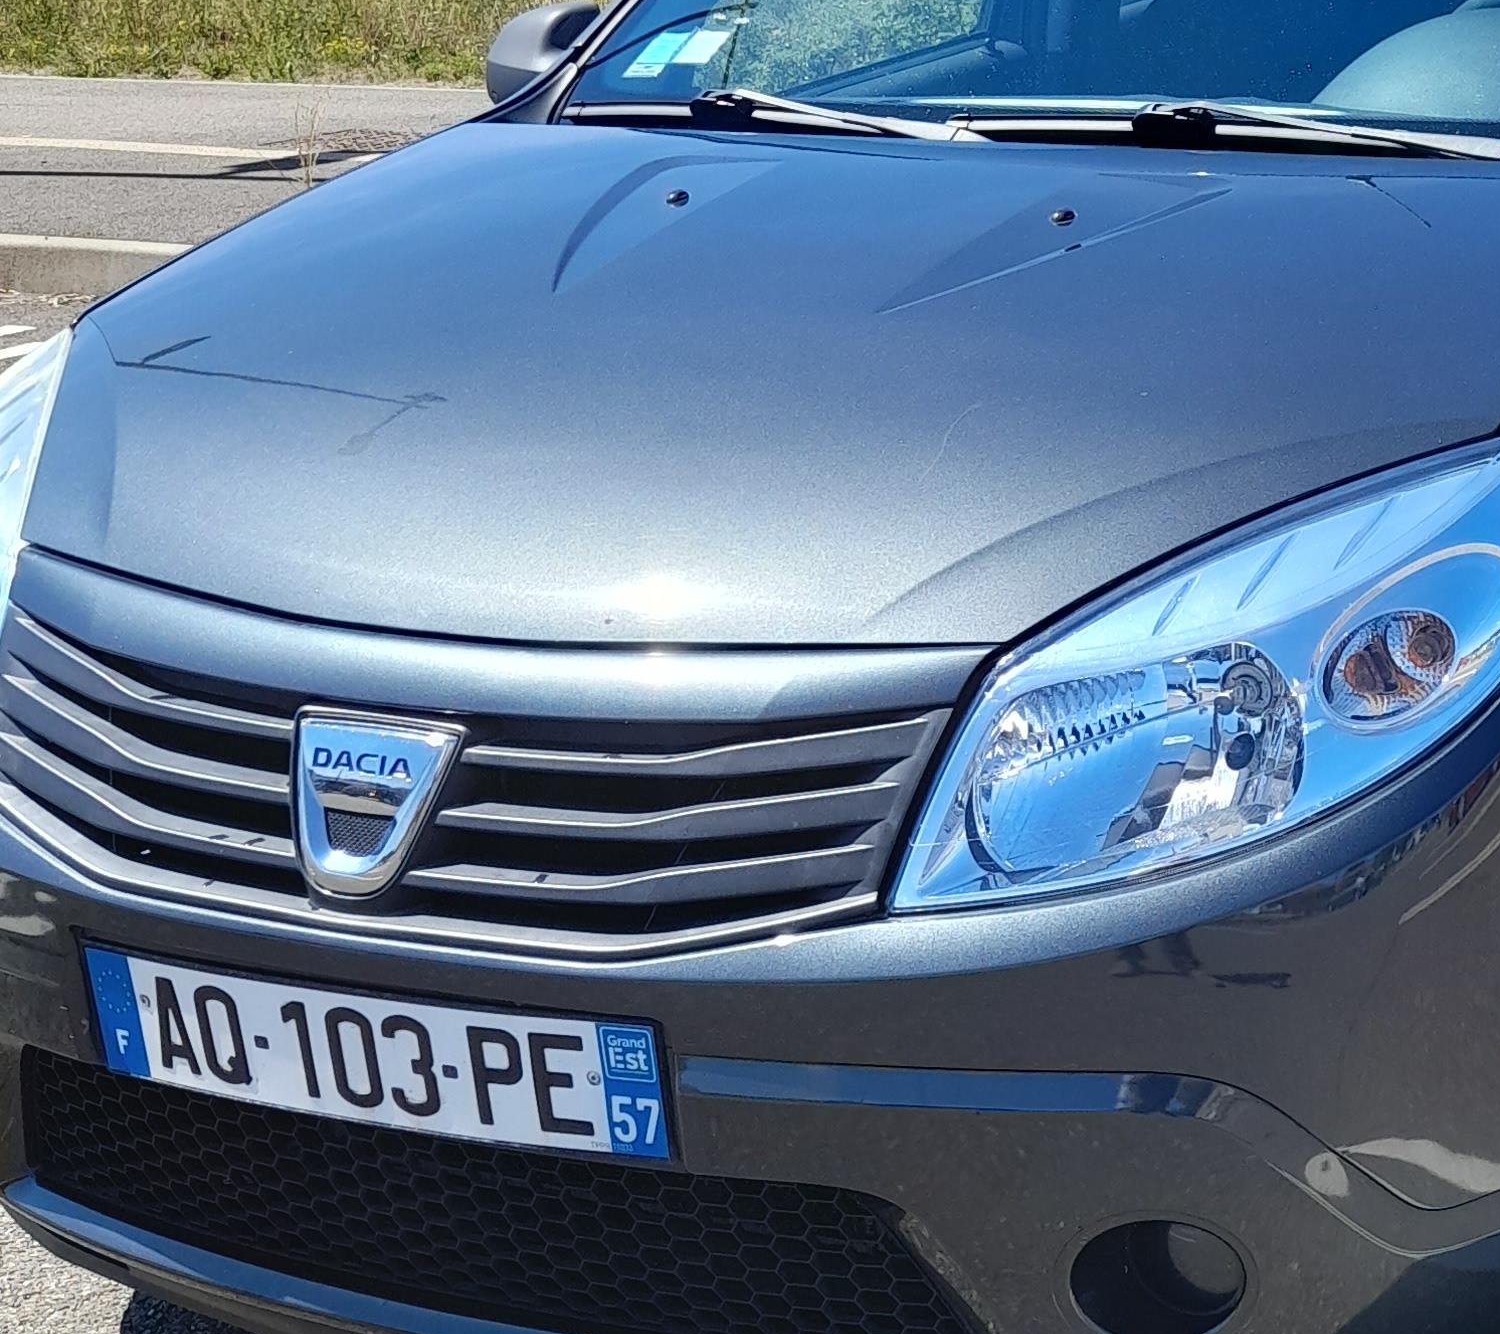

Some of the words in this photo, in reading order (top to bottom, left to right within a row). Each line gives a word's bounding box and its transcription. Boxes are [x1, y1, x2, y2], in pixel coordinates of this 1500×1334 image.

[311, 746, 412, 779] DACIA
[115, 1028, 129, 1055] F
[606, 1034, 646, 1049] Grand
[608, 1046, 649, 1072] Est
[610, 1094, 660, 1145] 57
